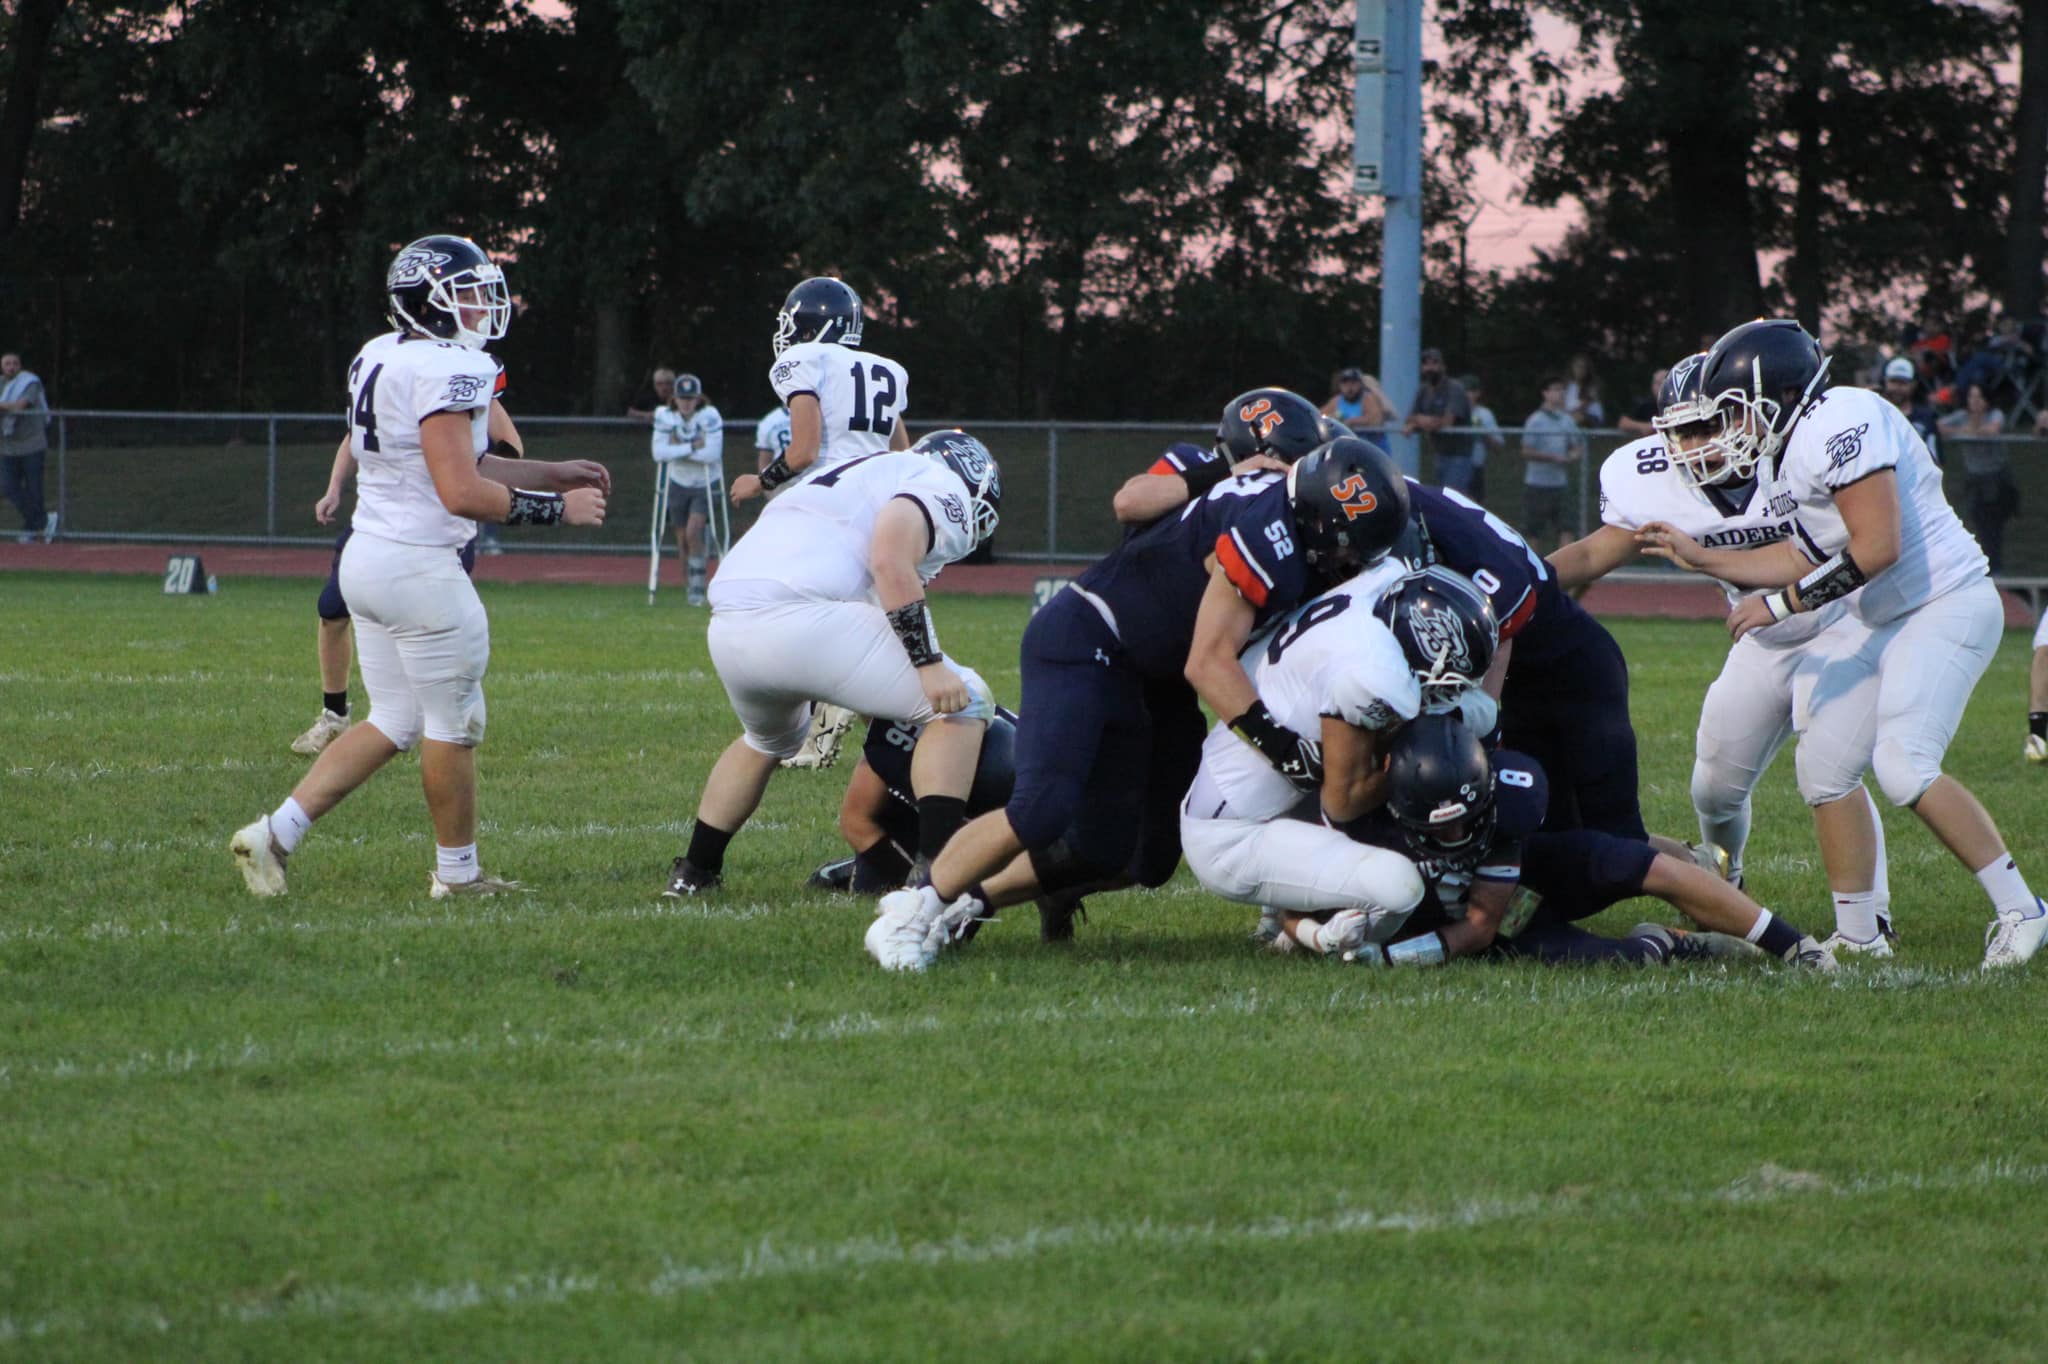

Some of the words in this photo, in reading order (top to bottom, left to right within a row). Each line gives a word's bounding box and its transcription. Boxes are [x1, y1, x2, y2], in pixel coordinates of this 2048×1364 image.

[848, 361, 897, 437] 12
[1240, 399, 1284, 438] 35
[1636, 446, 1669, 475] 58
[1330, 474, 1377, 521] 52
[1264, 519, 1294, 561] 52
[164, 558, 195, 593] 20
[1499, 768, 1534, 788] 8
